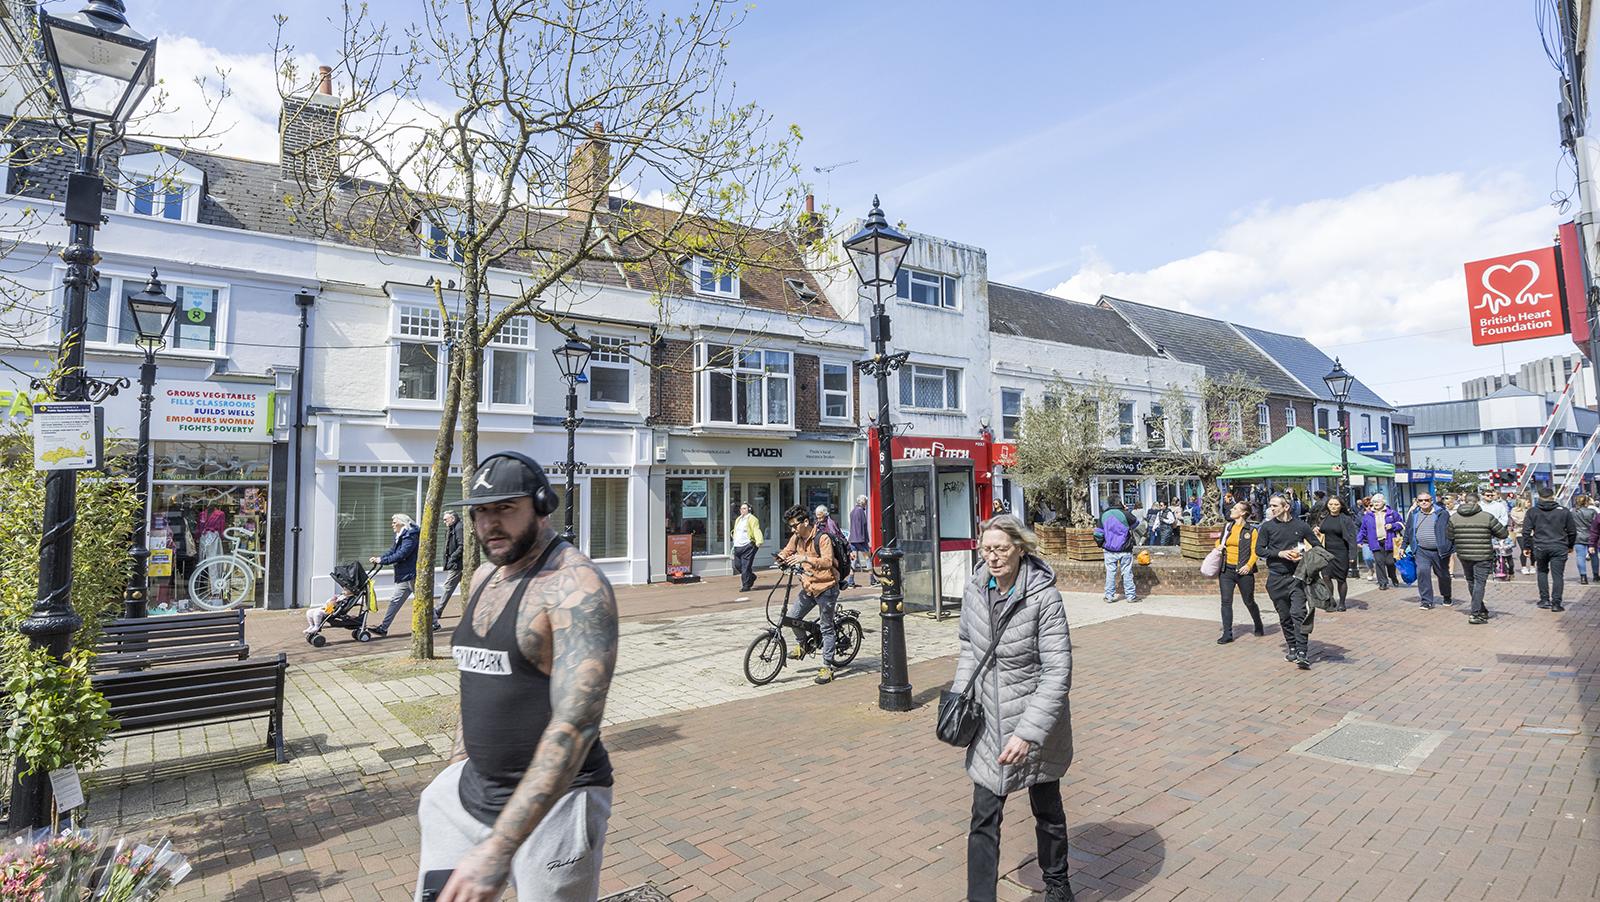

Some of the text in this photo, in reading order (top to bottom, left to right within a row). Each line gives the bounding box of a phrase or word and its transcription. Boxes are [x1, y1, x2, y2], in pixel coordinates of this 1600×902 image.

[1480, 309, 1551, 327] British Heart
[1480, 320, 1552, 336] Foundation
[167, 390, 256, 400] GROWS VEGETABLES
[170, 398, 256, 408] FILLS CLASSROOMS
[194, 408, 255, 417] BUILDS WELLS
[166, 415, 255, 425] EMPOWERS WOMEN
[179, 424, 254, 433] FIGHTS POVERTY
[747, 447, 783, 458] HOWDEN
